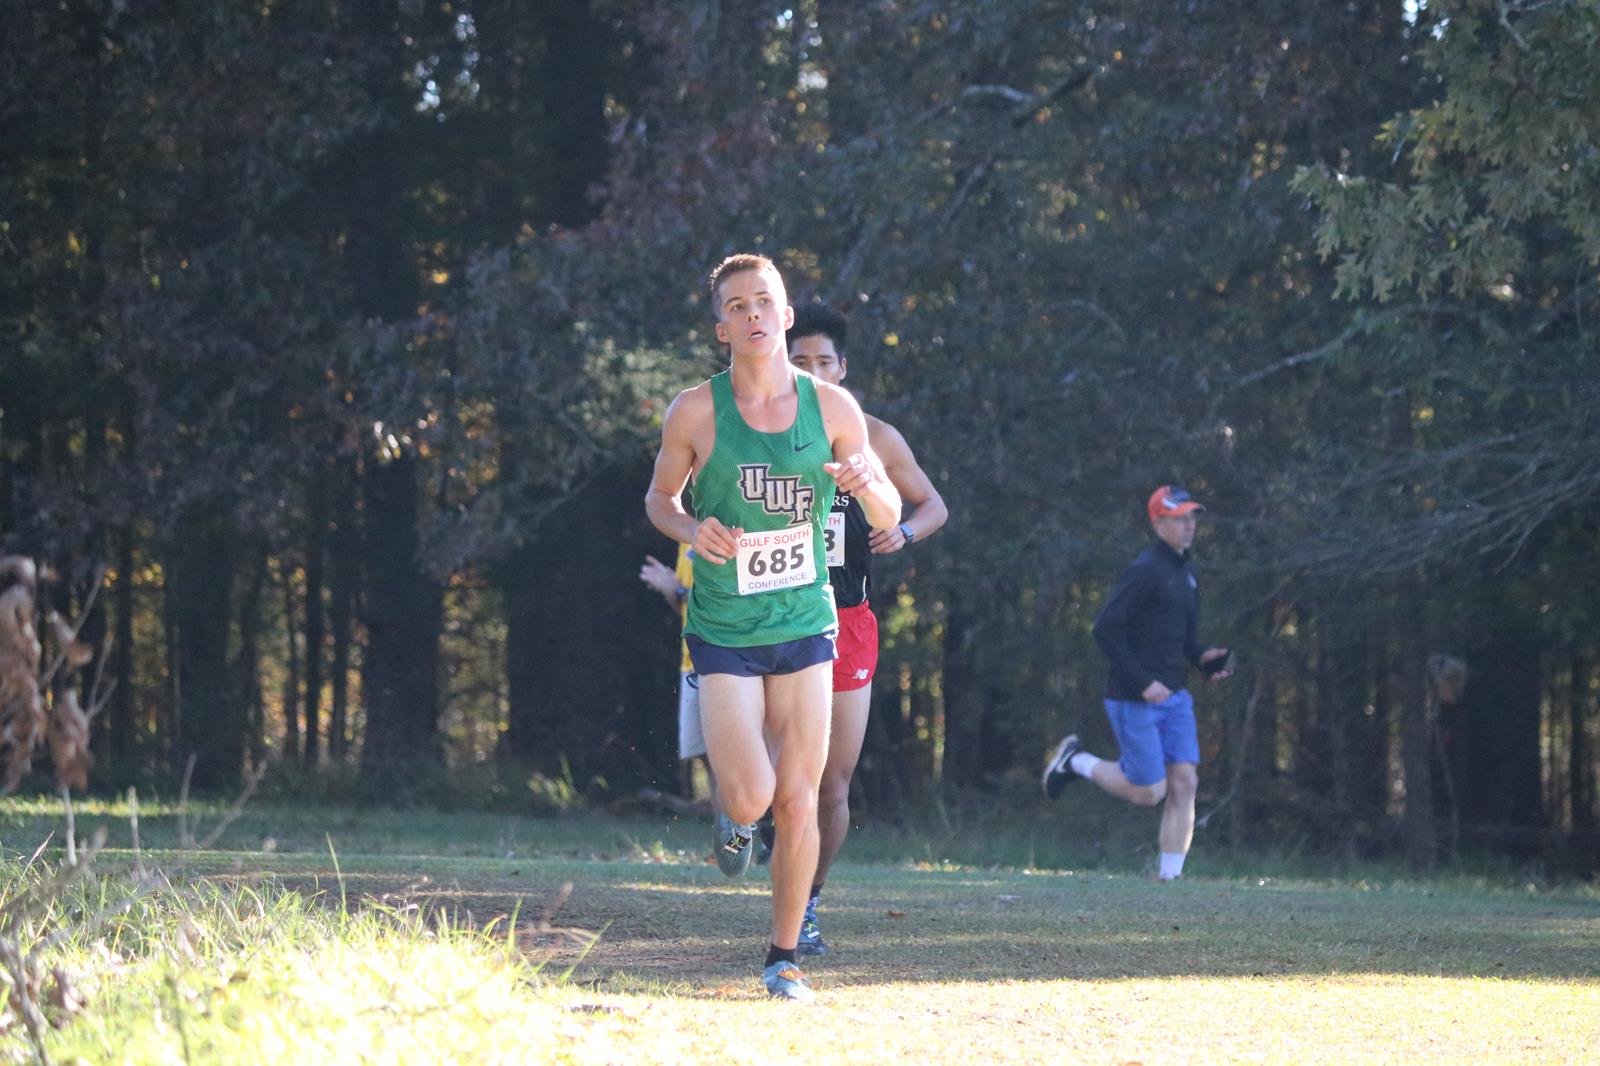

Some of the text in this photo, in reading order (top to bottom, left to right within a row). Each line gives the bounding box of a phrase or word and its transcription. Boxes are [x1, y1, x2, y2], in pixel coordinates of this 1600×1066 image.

[737, 464, 814, 526] UWF
[740, 537, 771, 548] GULF
[774, 529, 809, 545] SOUTH
[748, 543, 805, 577] 685
[748, 572, 807, 590] CONFERENCE
